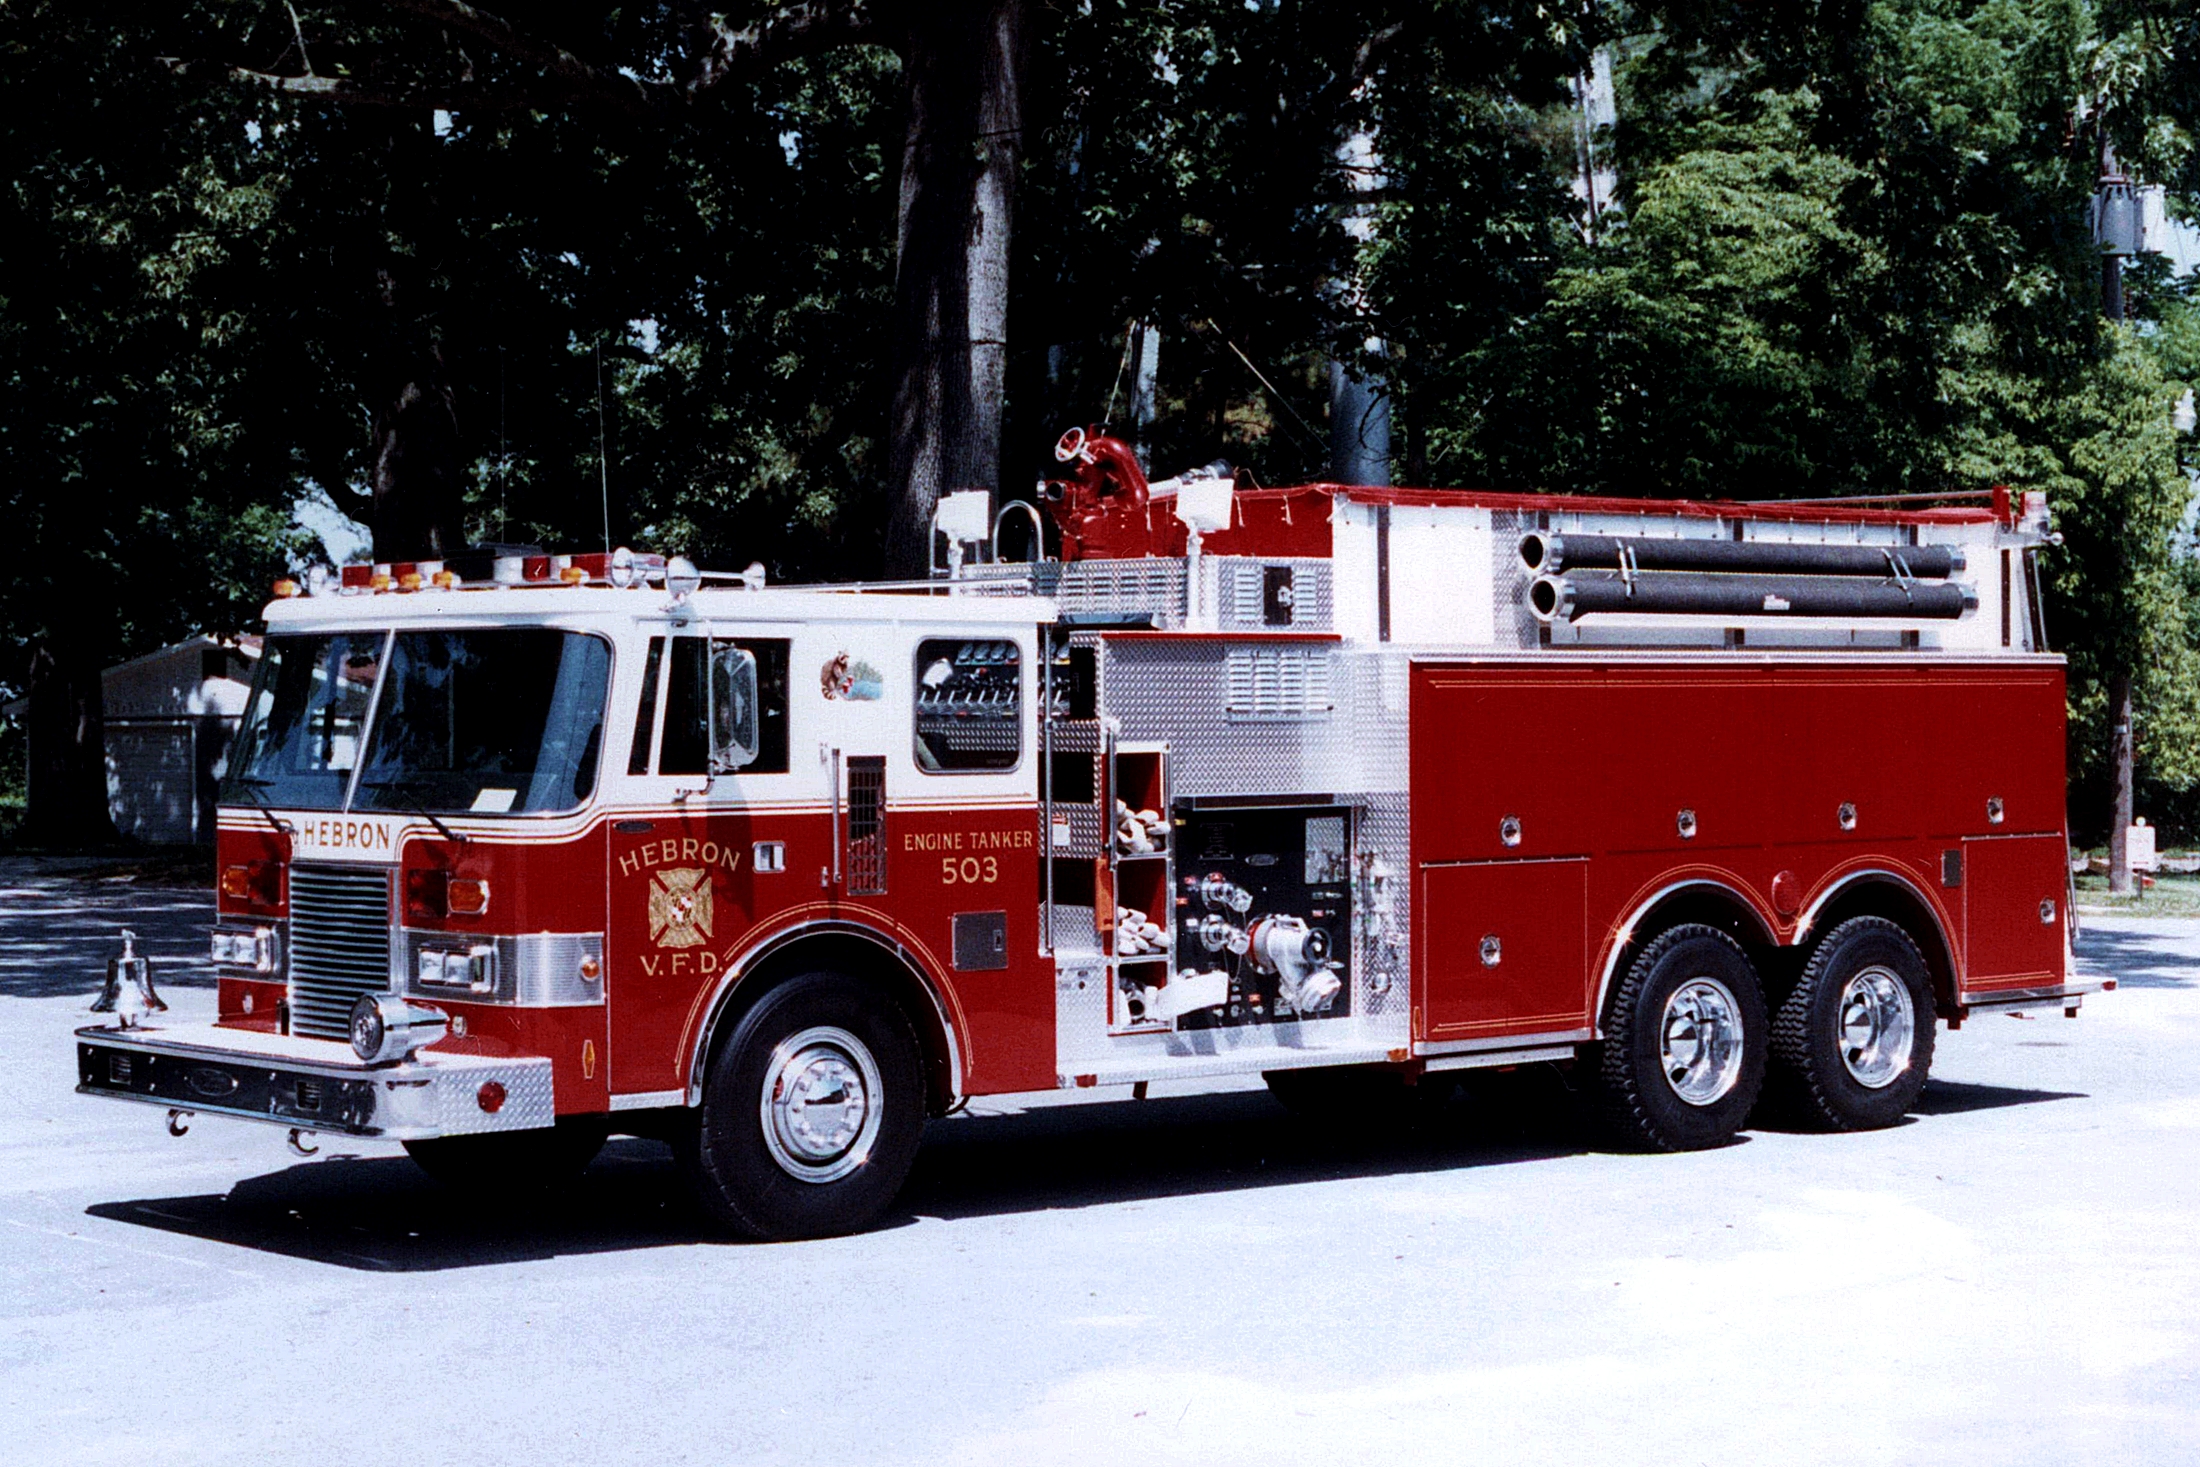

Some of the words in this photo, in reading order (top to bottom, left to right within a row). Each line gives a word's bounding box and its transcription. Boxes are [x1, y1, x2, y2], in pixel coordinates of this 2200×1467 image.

[304, 821, 389, 850] HEBRON
[904, 832, 963, 851] ENGINE
[969, 830, 1033, 849] TANKER
[618, 837, 741, 877] HEBRON
[942, 855, 998, 885] 503
